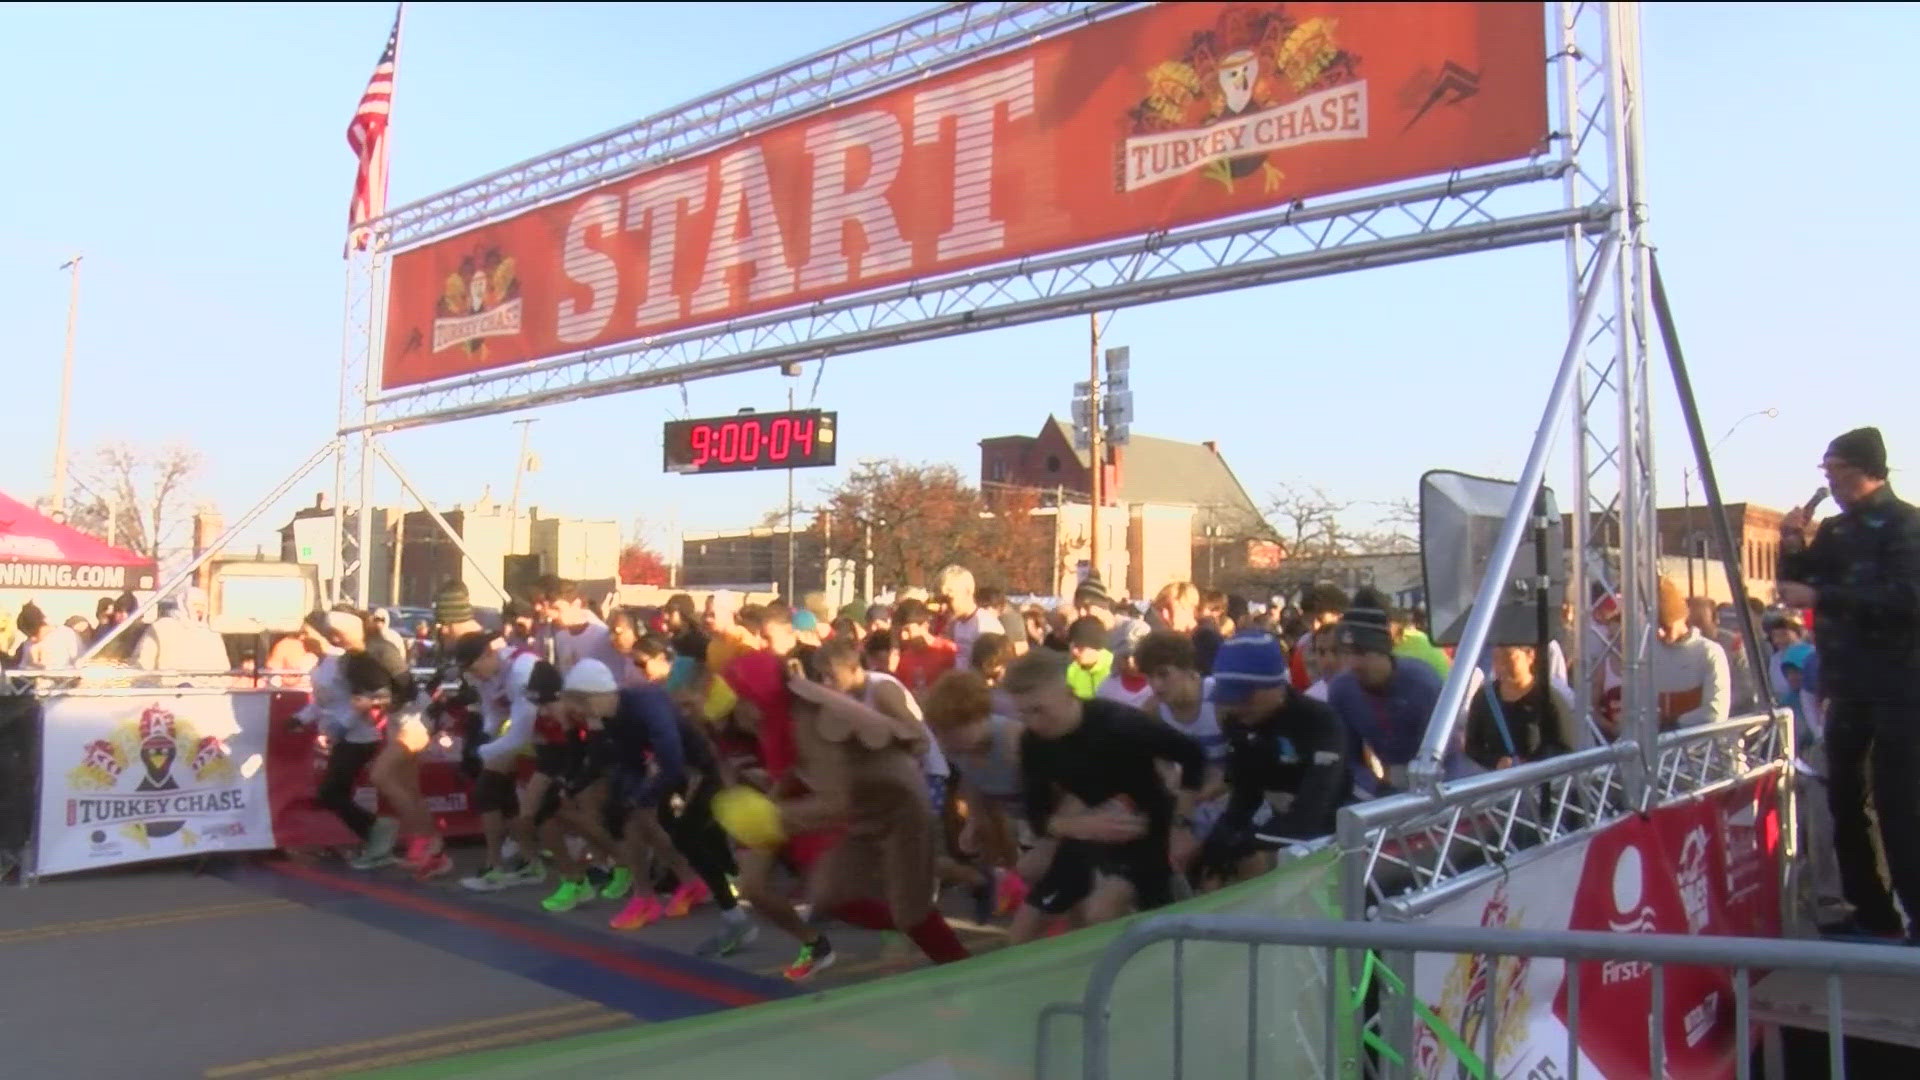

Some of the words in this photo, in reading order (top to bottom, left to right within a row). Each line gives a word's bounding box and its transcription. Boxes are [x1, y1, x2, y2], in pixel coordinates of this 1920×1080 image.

[1132, 126, 1246, 180] TURKEY
[1253, 92, 1360, 145] CHASE
[557, 59, 1034, 343] START
[0, 563, 125, 588] NNING.COM
[80, 799, 171, 823] TURKEY
[174, 789, 246, 812] CHASE
